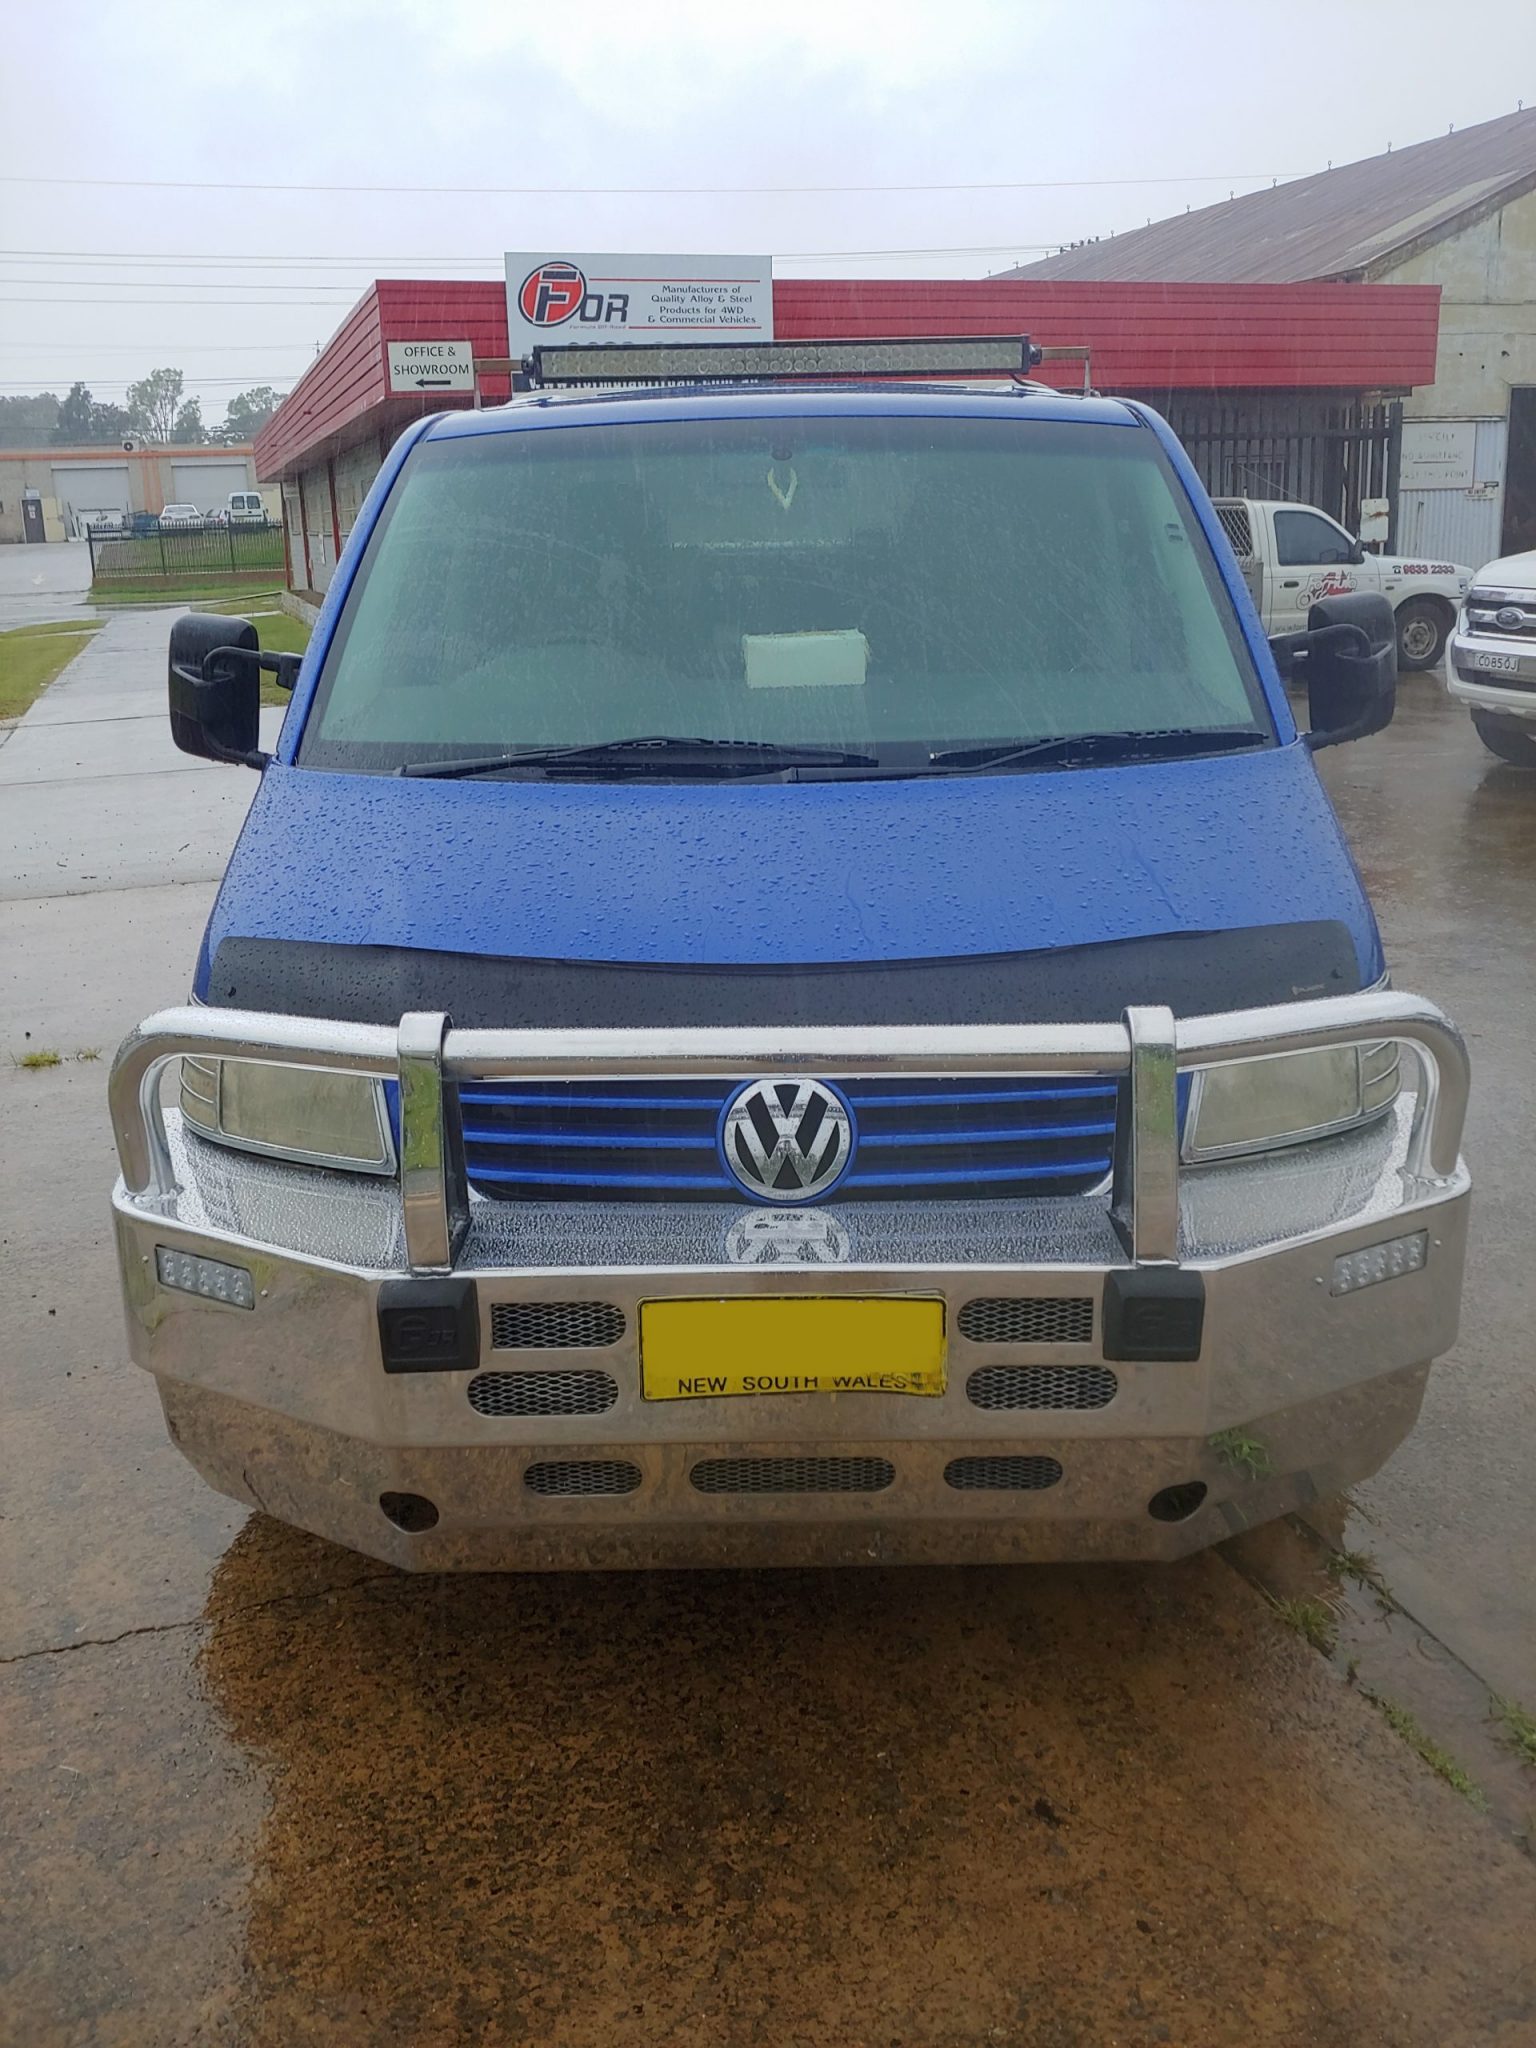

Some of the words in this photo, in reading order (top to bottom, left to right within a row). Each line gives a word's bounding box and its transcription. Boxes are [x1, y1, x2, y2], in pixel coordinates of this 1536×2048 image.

[662, 285, 728, 294] Manufacturers
[731, 285, 741, 294] of
[651, 294, 686, 304] Quality
[690, 294, 714, 304] Alloy
[717, 295, 726, 303] &
[729, 295, 753, 303] Steel
[659, 306, 701, 314] Products
[704, 306, 717, 314] for
[721, 306, 744, 314] 4WD
[647, 315, 656, 323] &
[659, 315, 715, 324] Commercial
[719, 315, 756, 324] Vehicles
[404, 346, 444, 357] OFFICE
[447, 346, 456, 357] &
[394, 364, 469, 375] SHOWROOM
[678, 1377, 728, 1394] NEW
[742, 1376, 819, 1391] SOUTH
[832, 1375, 907, 1389] WALES
